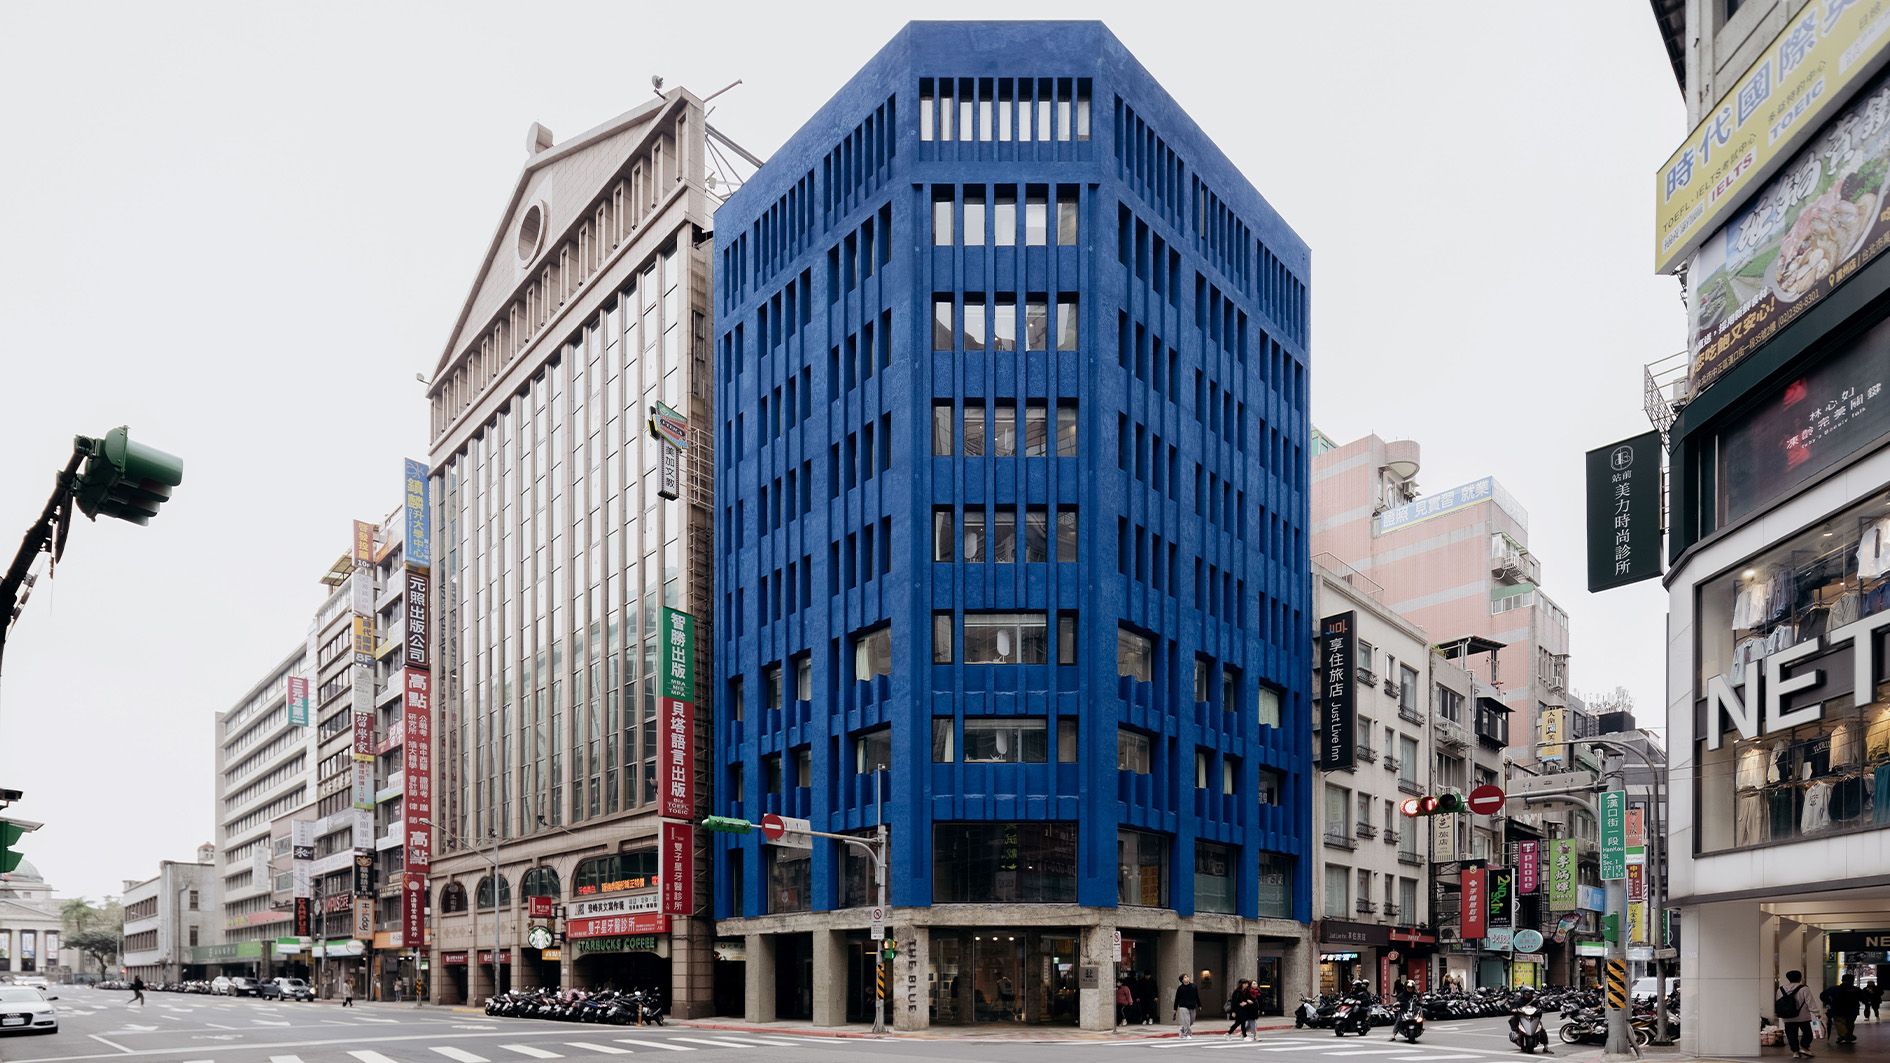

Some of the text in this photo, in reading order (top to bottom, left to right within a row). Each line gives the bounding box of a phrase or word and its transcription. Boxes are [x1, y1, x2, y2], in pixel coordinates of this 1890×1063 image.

[1770, 80, 1824, 139] TOEIC
[1711, 152, 1753, 202] IELTS
[1663, 203, 1690, 232] TOEFL
[1611, 470, 1632, 483] 站前
[1615, 483, 1631, 576] 美力時尚診所
[409, 575, 426, 663] 元照出版公司
[356, 653, 372, 662] 8F
[670, 612, 686, 680] 智勝出版
[1328, 637, 1344, 698] 享住旅店
[408, 672, 427, 710] 高點
[1707, 607, 1890, 752] NET
[355, 714, 369, 753] 留學家
[670, 701, 686, 798] 貝塔語言出版
[1331, 702, 1342, 761] Just Live Inn
[667, 801, 689, 811] TOEFL
[668, 807, 688, 815] TOEIC
[1607, 799, 1619, 846] 漢口街一段
[409, 831, 428, 866] 高點
[673, 842, 683, 911] 雙子星牙醫診所
[576, 937, 656, 951] STARBUCKS COFFEE
[588, 917, 635, 935] 雙子星牙醫診所
[908, 975, 917, 1012] BLUE
